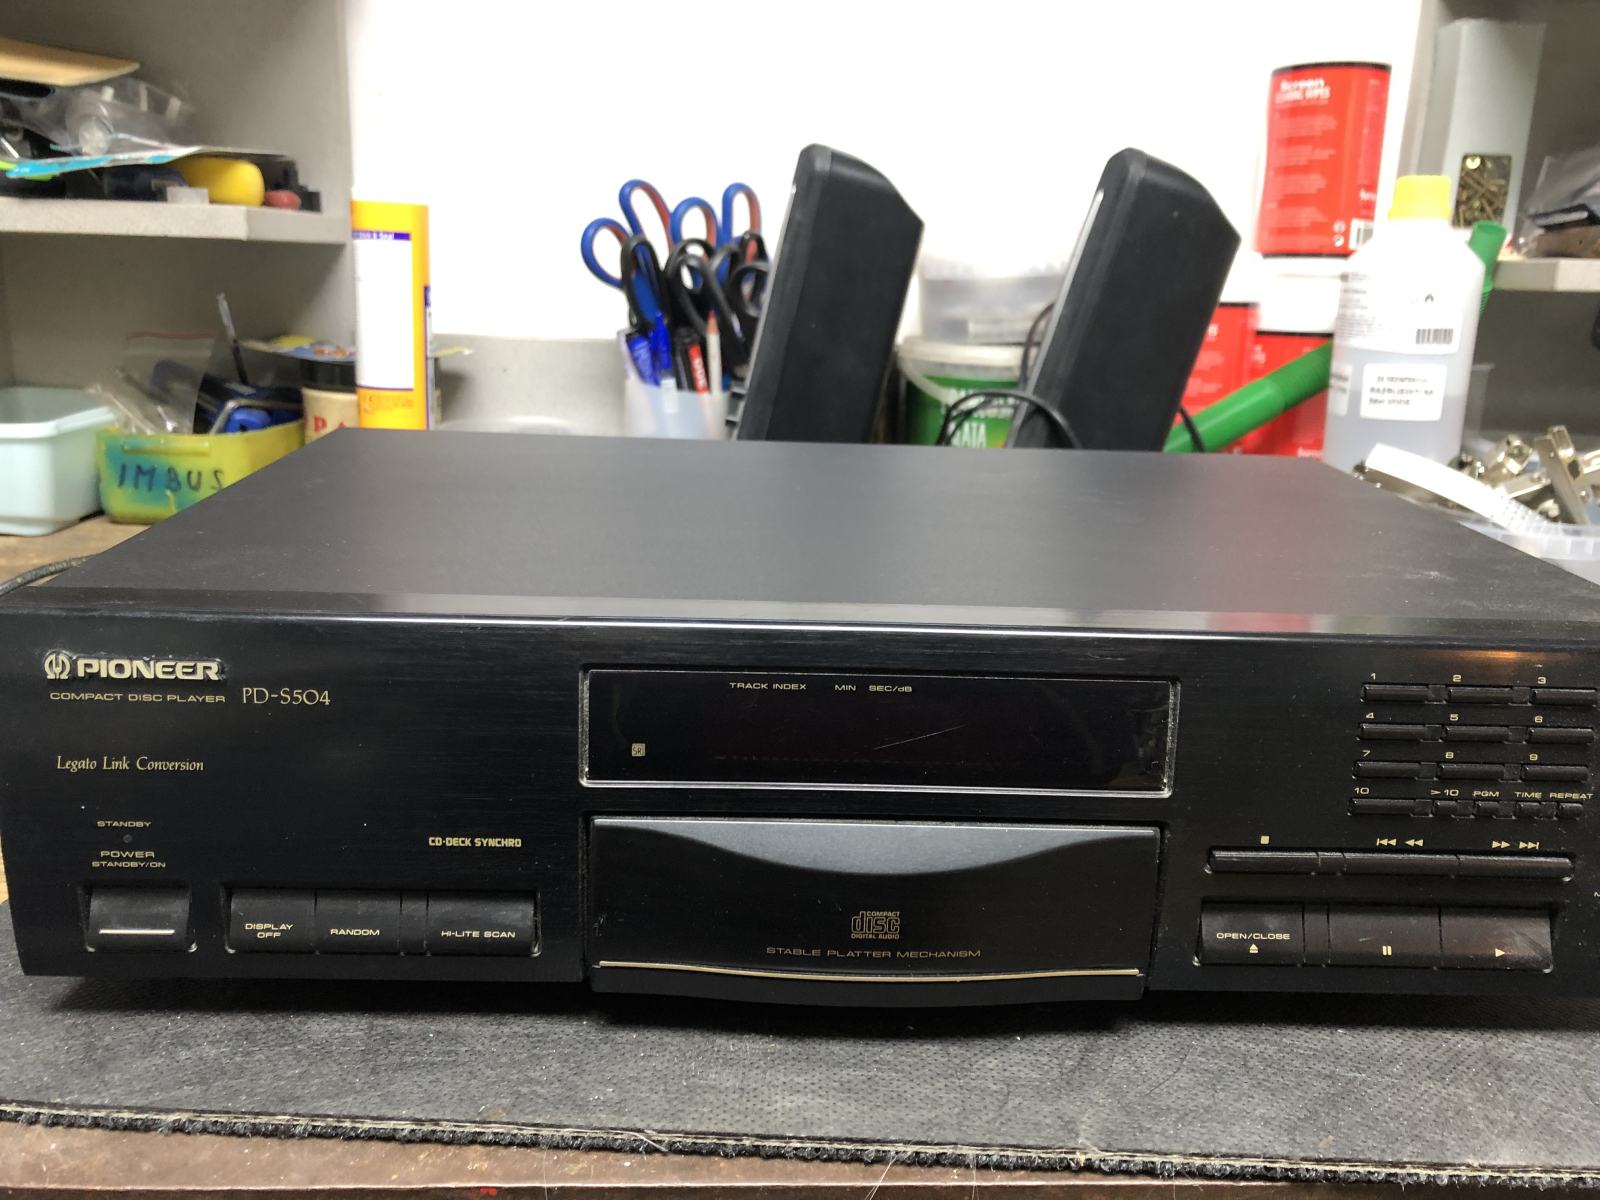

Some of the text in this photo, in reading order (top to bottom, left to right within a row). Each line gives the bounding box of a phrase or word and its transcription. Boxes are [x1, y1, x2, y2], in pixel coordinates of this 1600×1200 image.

[116, 464, 224, 492] IMBUS
[76, 659, 220, 680] PIONEER
[1452, 674, 1462, 682] 2
[1537, 676, 1547, 684] 3
[729, 682, 769, 690] TRACK
[49, 692, 226, 703] COMPACT DISC PLAYER
[241, 687, 331, 705] PD-S504
[1449, 713, 1459, 721] 5
[1534, 715, 1544, 723] 6
[1445, 751, 1454, 759] 8
[1529, 753, 1538, 761] 9
[56, 755, 204, 773] Legato Link Conversion
[1354, 787, 1370, 795] 10
[1514, 791, 1542, 799] TIME
[1549, 792, 1594, 800] REPEAT
[96, 820, 151, 828] STANDBY
[474, 837, 522, 848] SYNCHRO
[100, 850, 155, 858] POWER
[245, 923, 294, 931] DISPLAY
[257, 931, 282, 939] OFF
[330, 928, 380, 936] RANDOM
[441, 930, 516, 938] HI-LITE SCAN
[1216, 932, 1291, 940] OPEN/CLOSE
[766, 947, 981, 959] STABLE PLATTER MECHANISM
